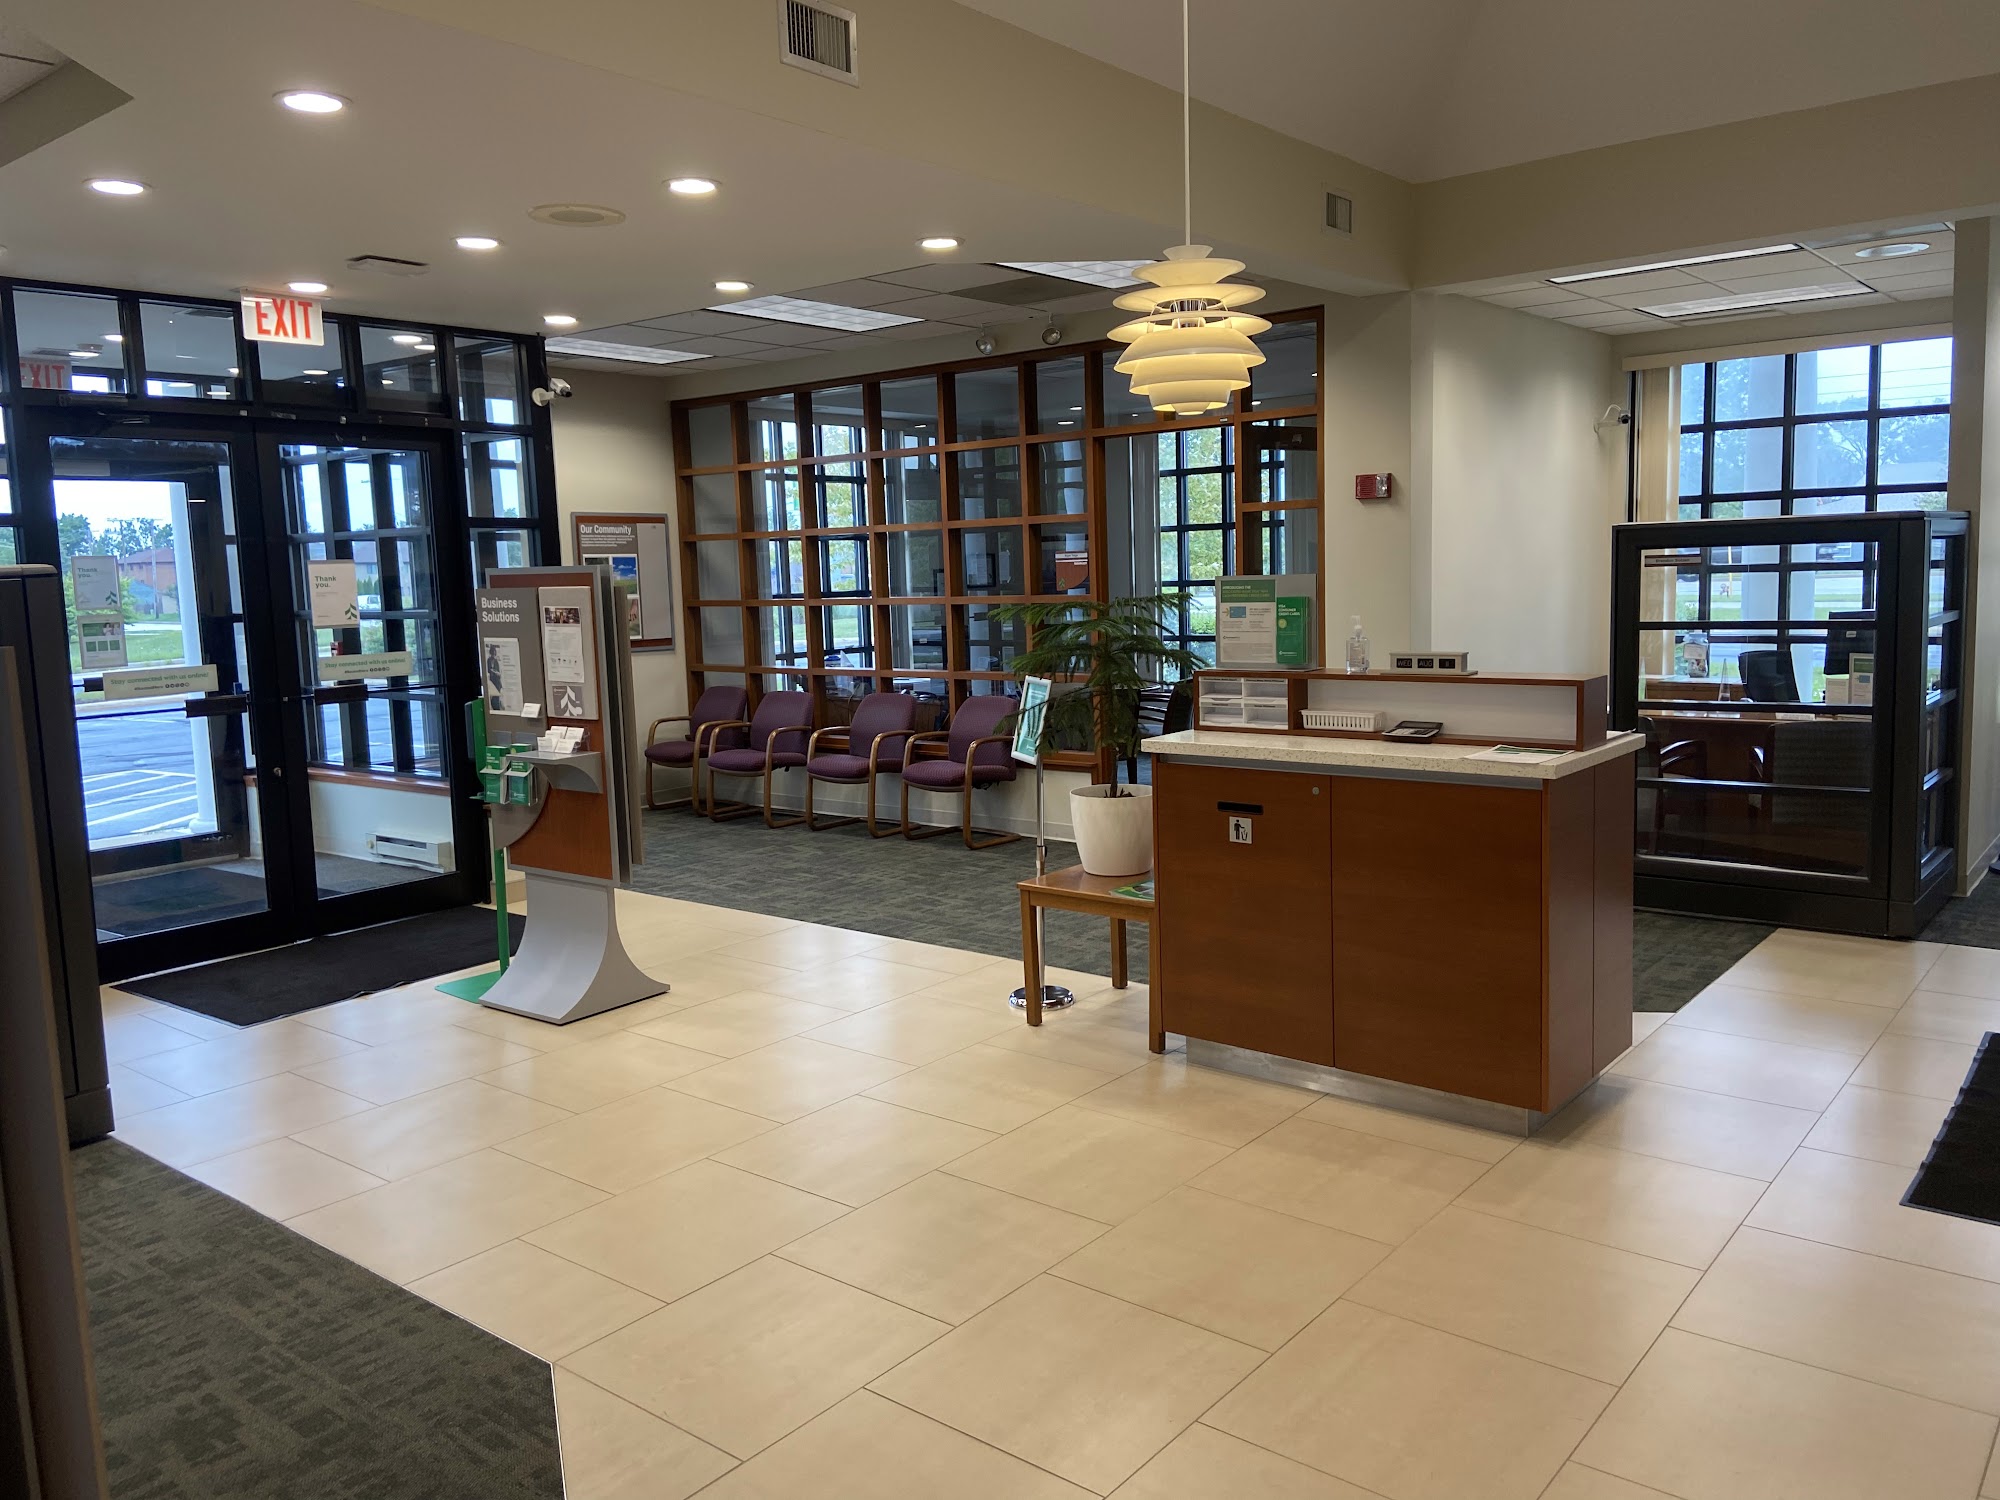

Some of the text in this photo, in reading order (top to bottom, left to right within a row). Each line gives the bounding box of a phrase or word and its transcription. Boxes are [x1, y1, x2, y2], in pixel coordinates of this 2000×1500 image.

[255, 295, 312, 339] EXIT
[580, 524, 631, 536] Our Community
[481, 597, 518, 609] Business
[482, 611, 520, 623] Solutions
